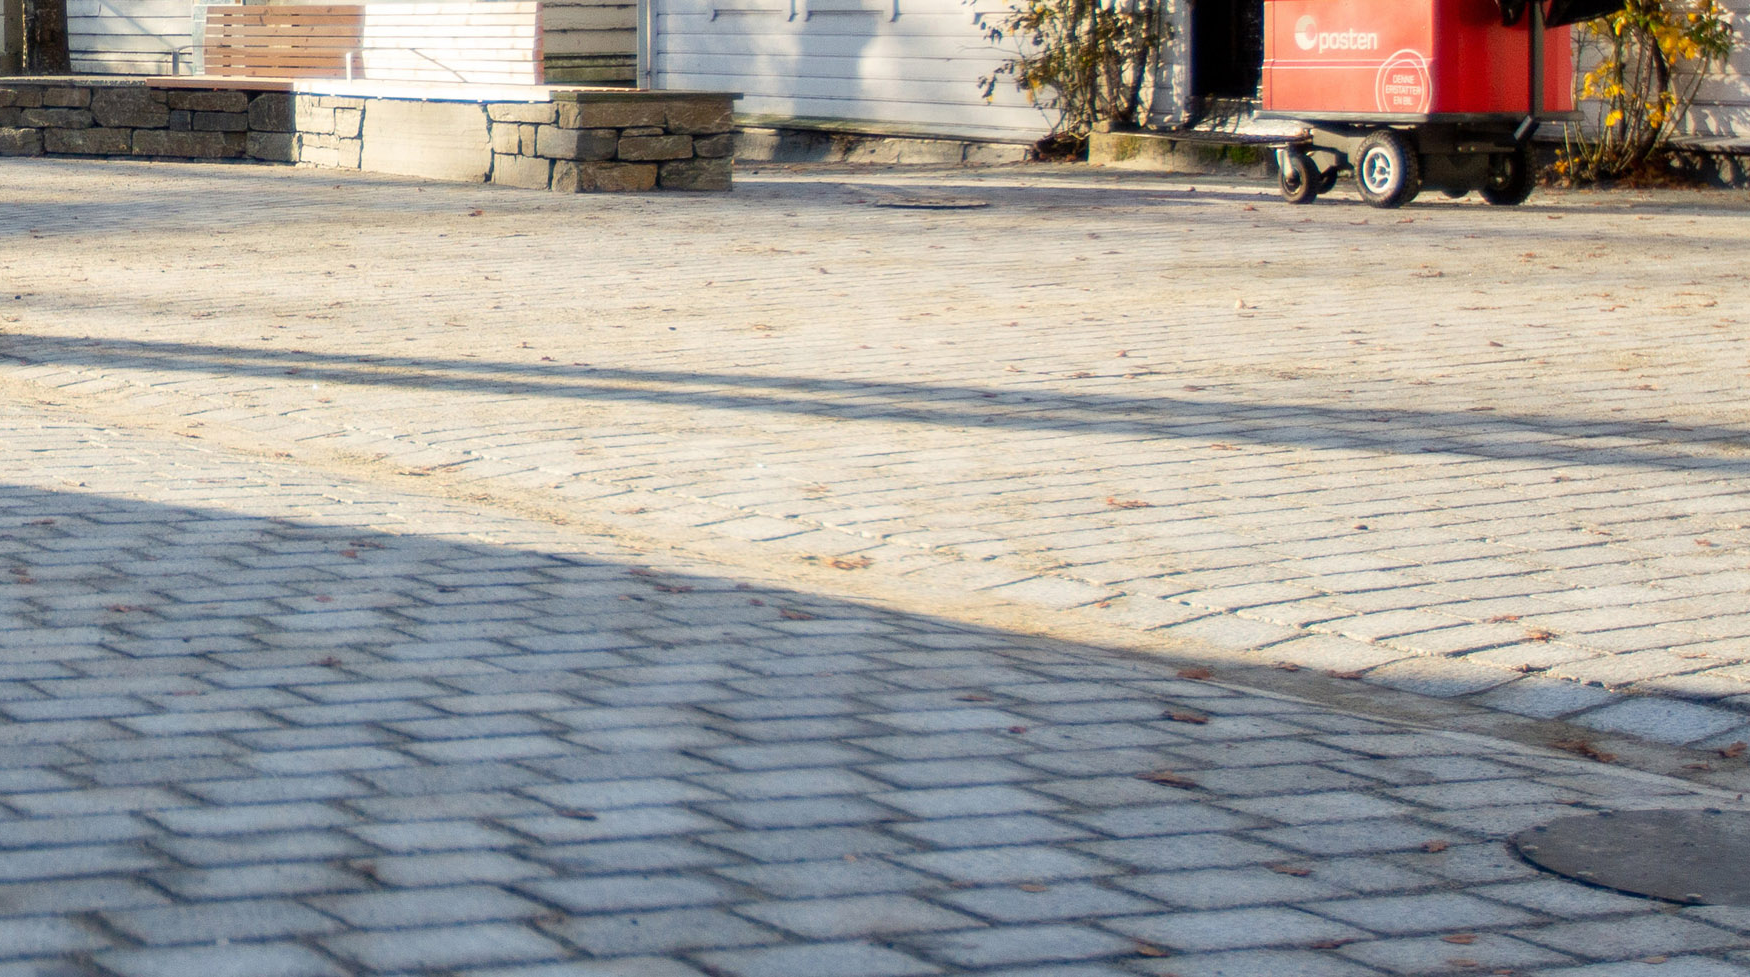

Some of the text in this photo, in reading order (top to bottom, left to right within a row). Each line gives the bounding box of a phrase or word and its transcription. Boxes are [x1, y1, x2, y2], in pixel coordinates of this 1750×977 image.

[1318, 27, 1378, 54] posten
[1392, 74, 1415, 84] DENNE
[1385, 84, 1422, 95] ERSTATTER
[1393, 95, 1402, 105] EN
